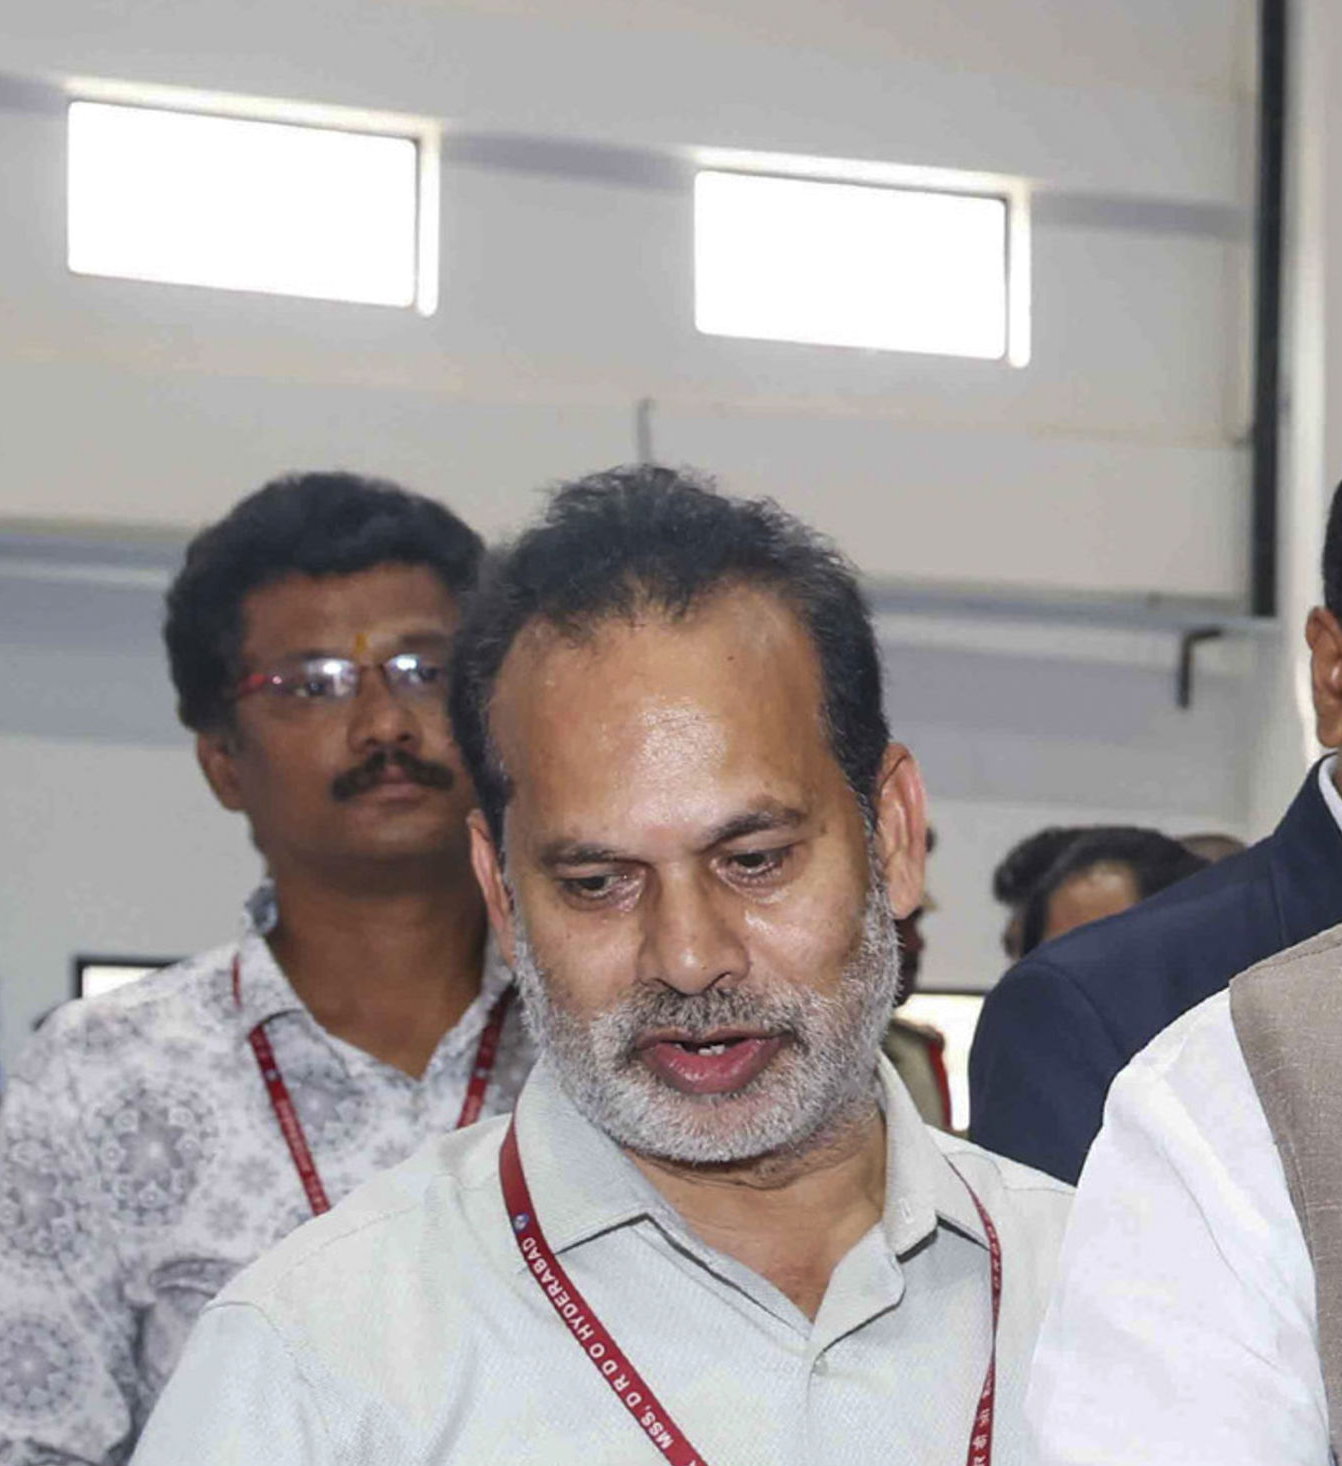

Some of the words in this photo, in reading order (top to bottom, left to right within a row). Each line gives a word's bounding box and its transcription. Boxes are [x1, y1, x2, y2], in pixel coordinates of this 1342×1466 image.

[521, 1237, 593, 1340] HYDERABAD
[589, 1342, 605, 1358] O
[602, 1359, 618, 1376] D
[613, 1374, 630, 1392] R
[625, 1391, 642, 1408] D
[640, 1405, 674, 1449] MSS,
